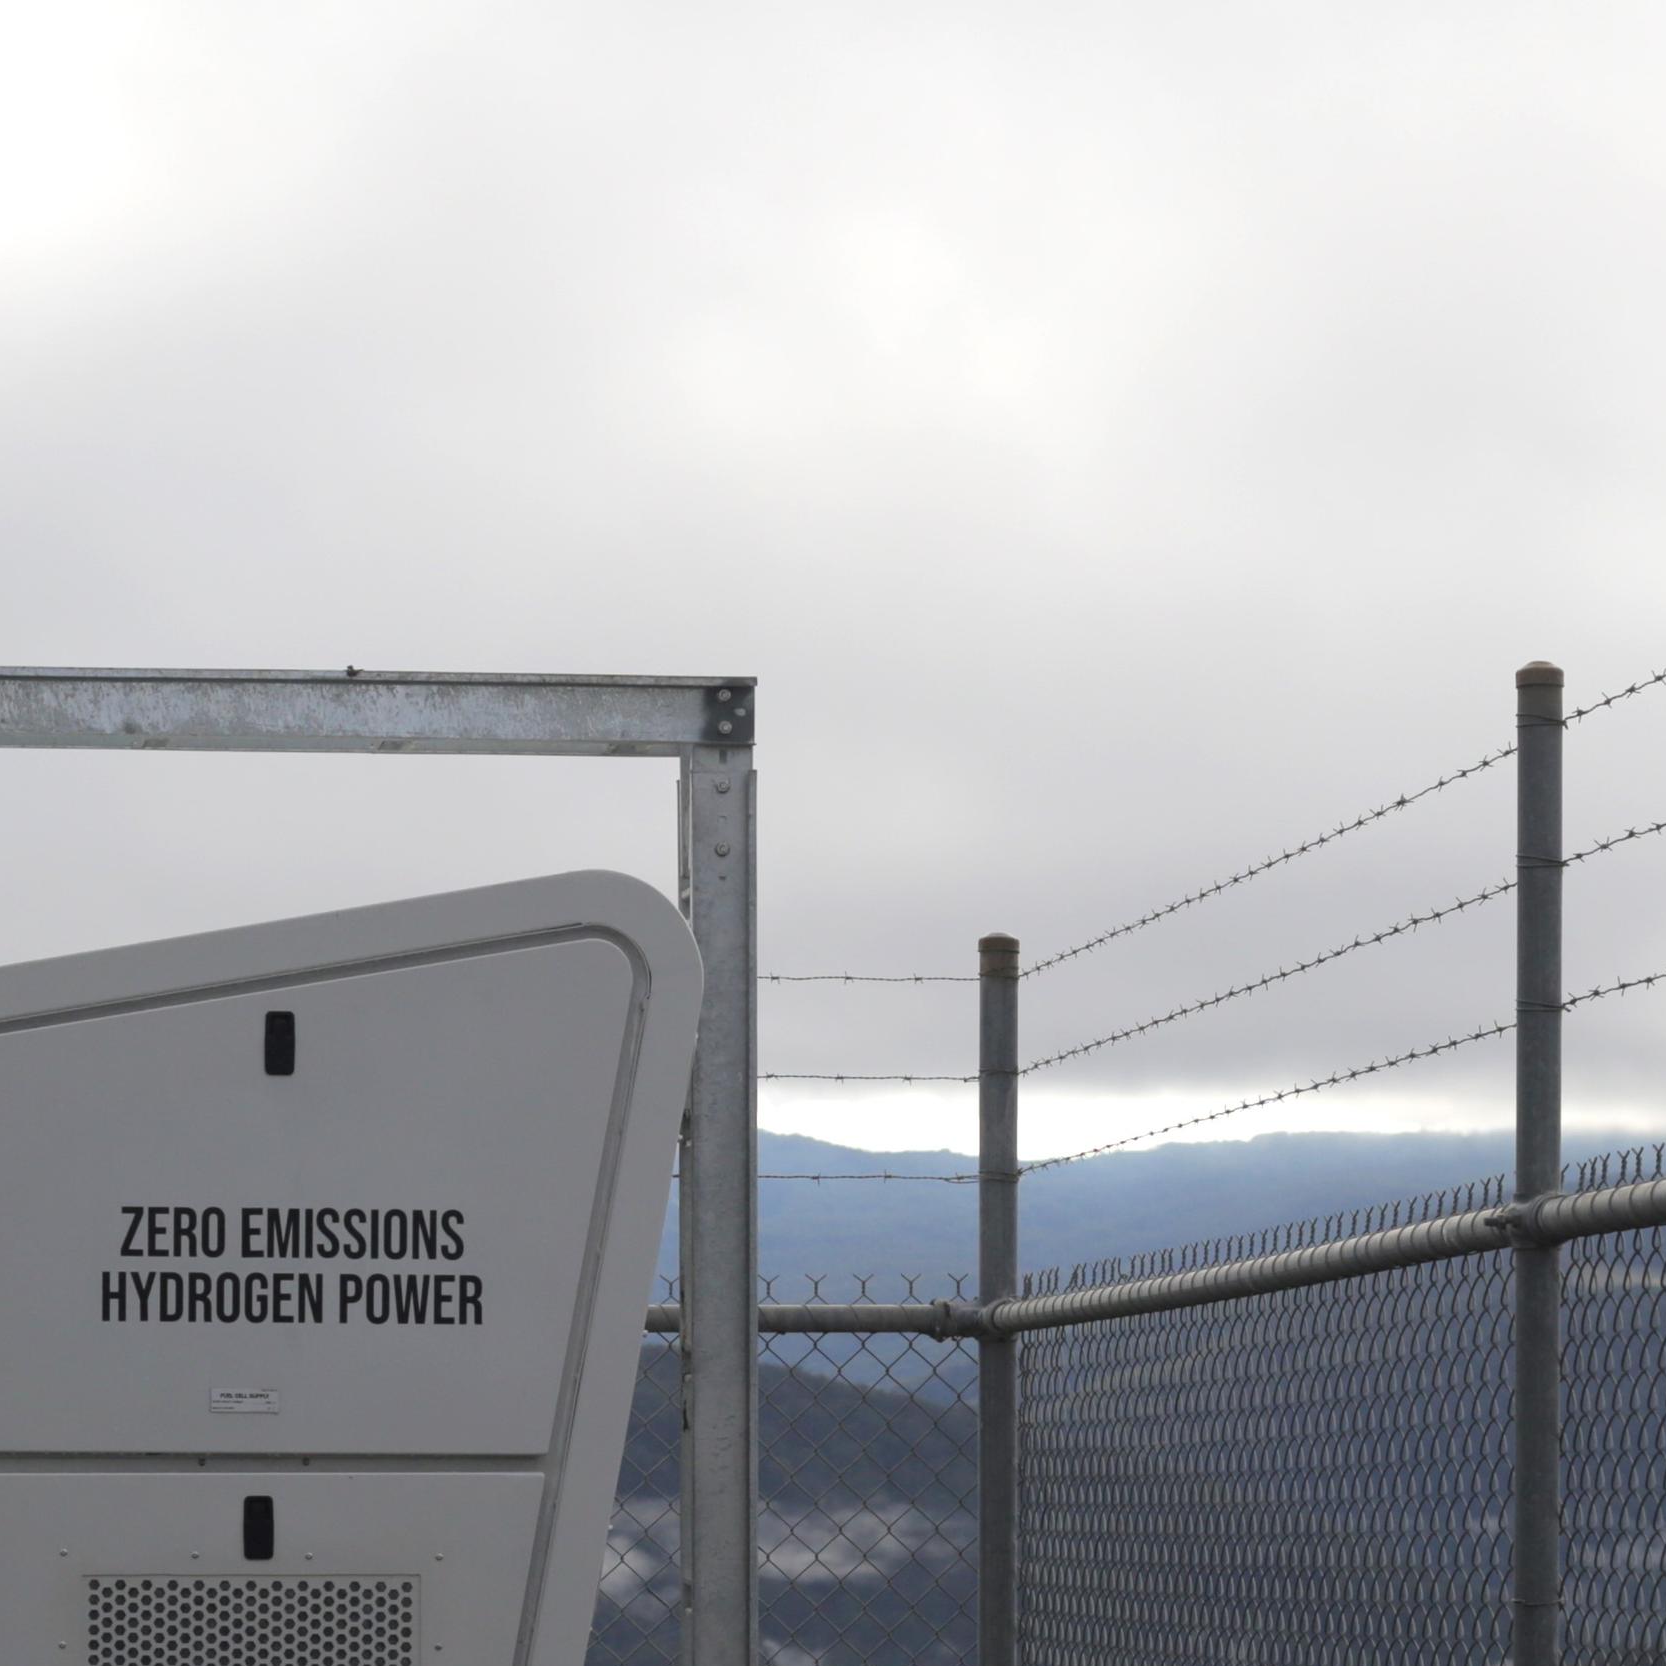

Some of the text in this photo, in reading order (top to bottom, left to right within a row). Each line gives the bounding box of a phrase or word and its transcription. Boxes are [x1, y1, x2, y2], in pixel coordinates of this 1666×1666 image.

[120, 1206, 465, 1261] ZERO EMISSIONS
[101, 1271, 483, 1325] HYDROGEN POWER
